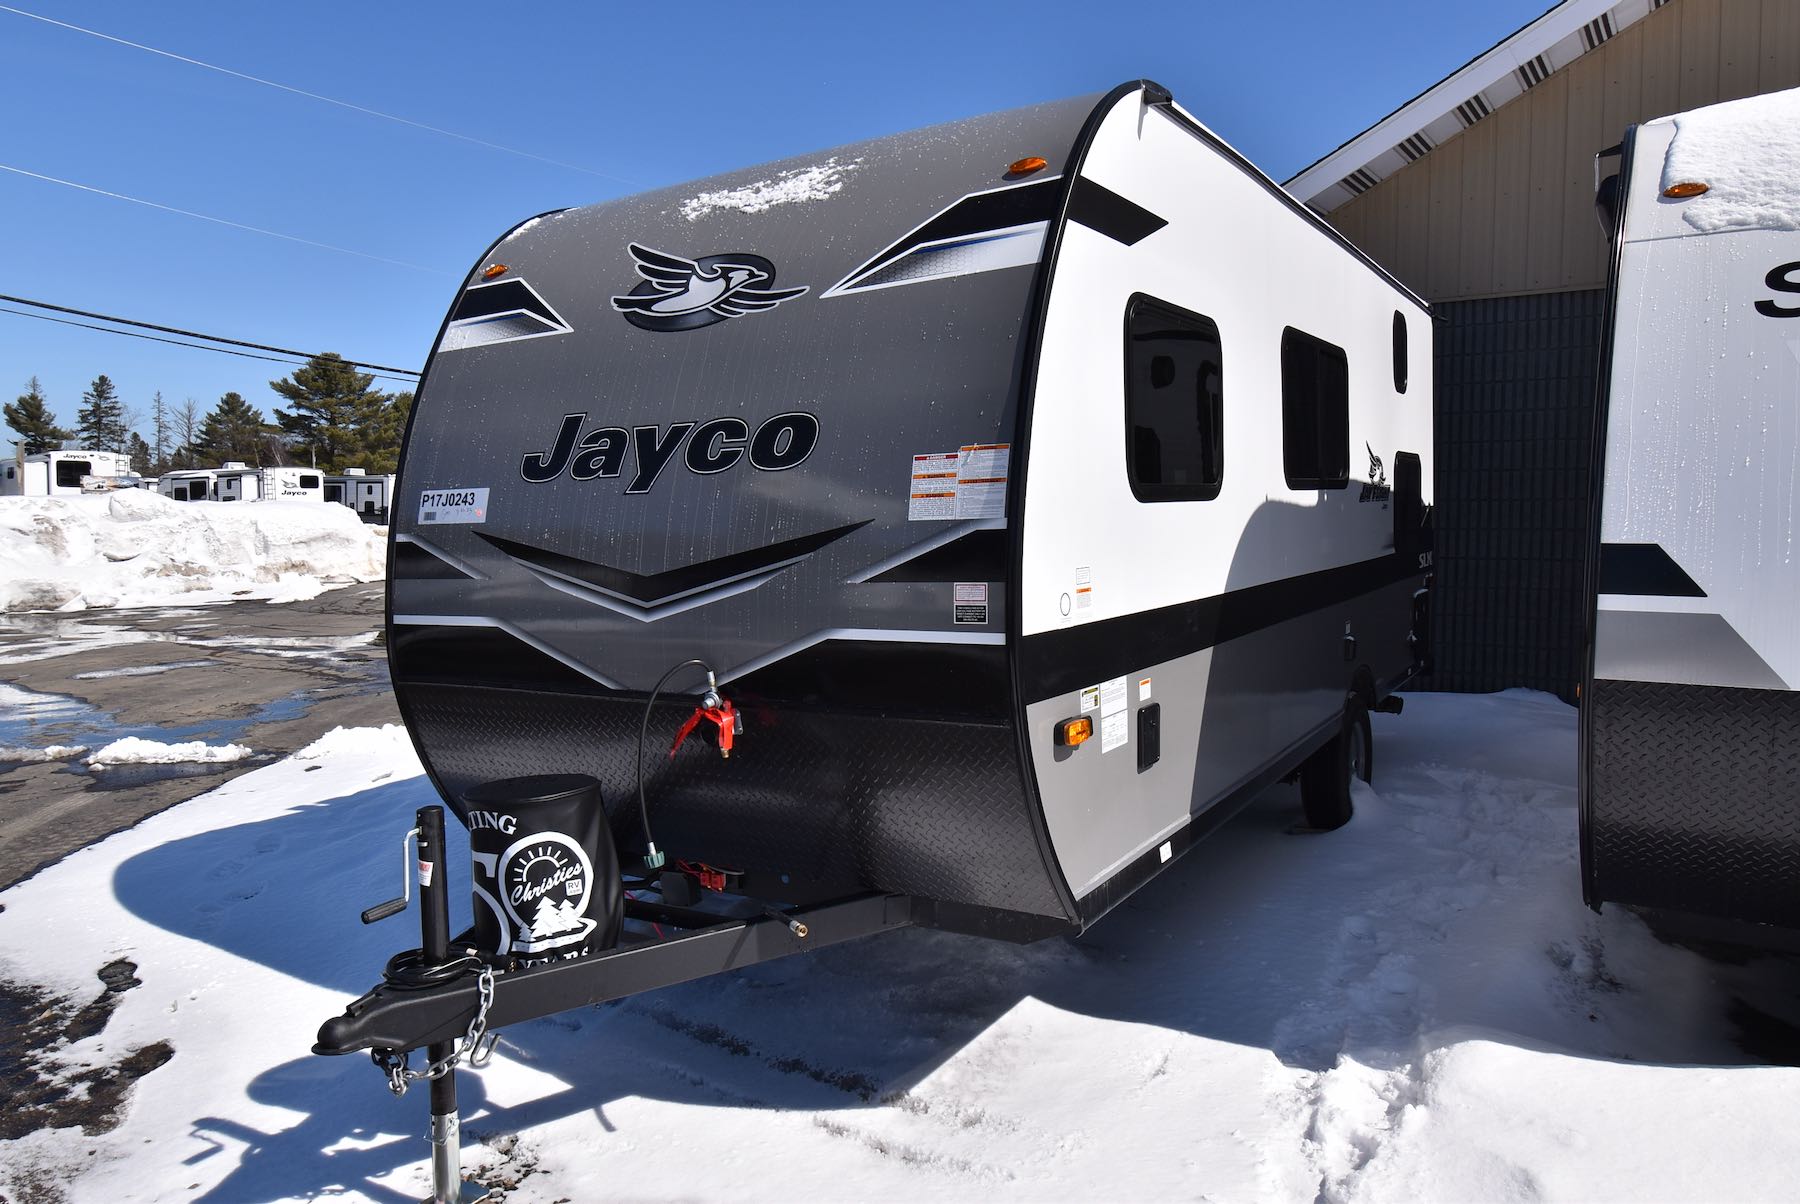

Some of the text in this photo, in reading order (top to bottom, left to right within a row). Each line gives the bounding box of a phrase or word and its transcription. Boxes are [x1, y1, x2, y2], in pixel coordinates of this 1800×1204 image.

[520, 411, 820, 495] Jayco
[421, 491, 475, 508] P17J0243
[510, 862, 583, 907] Christies
[567, 880, 580, 890] RV
